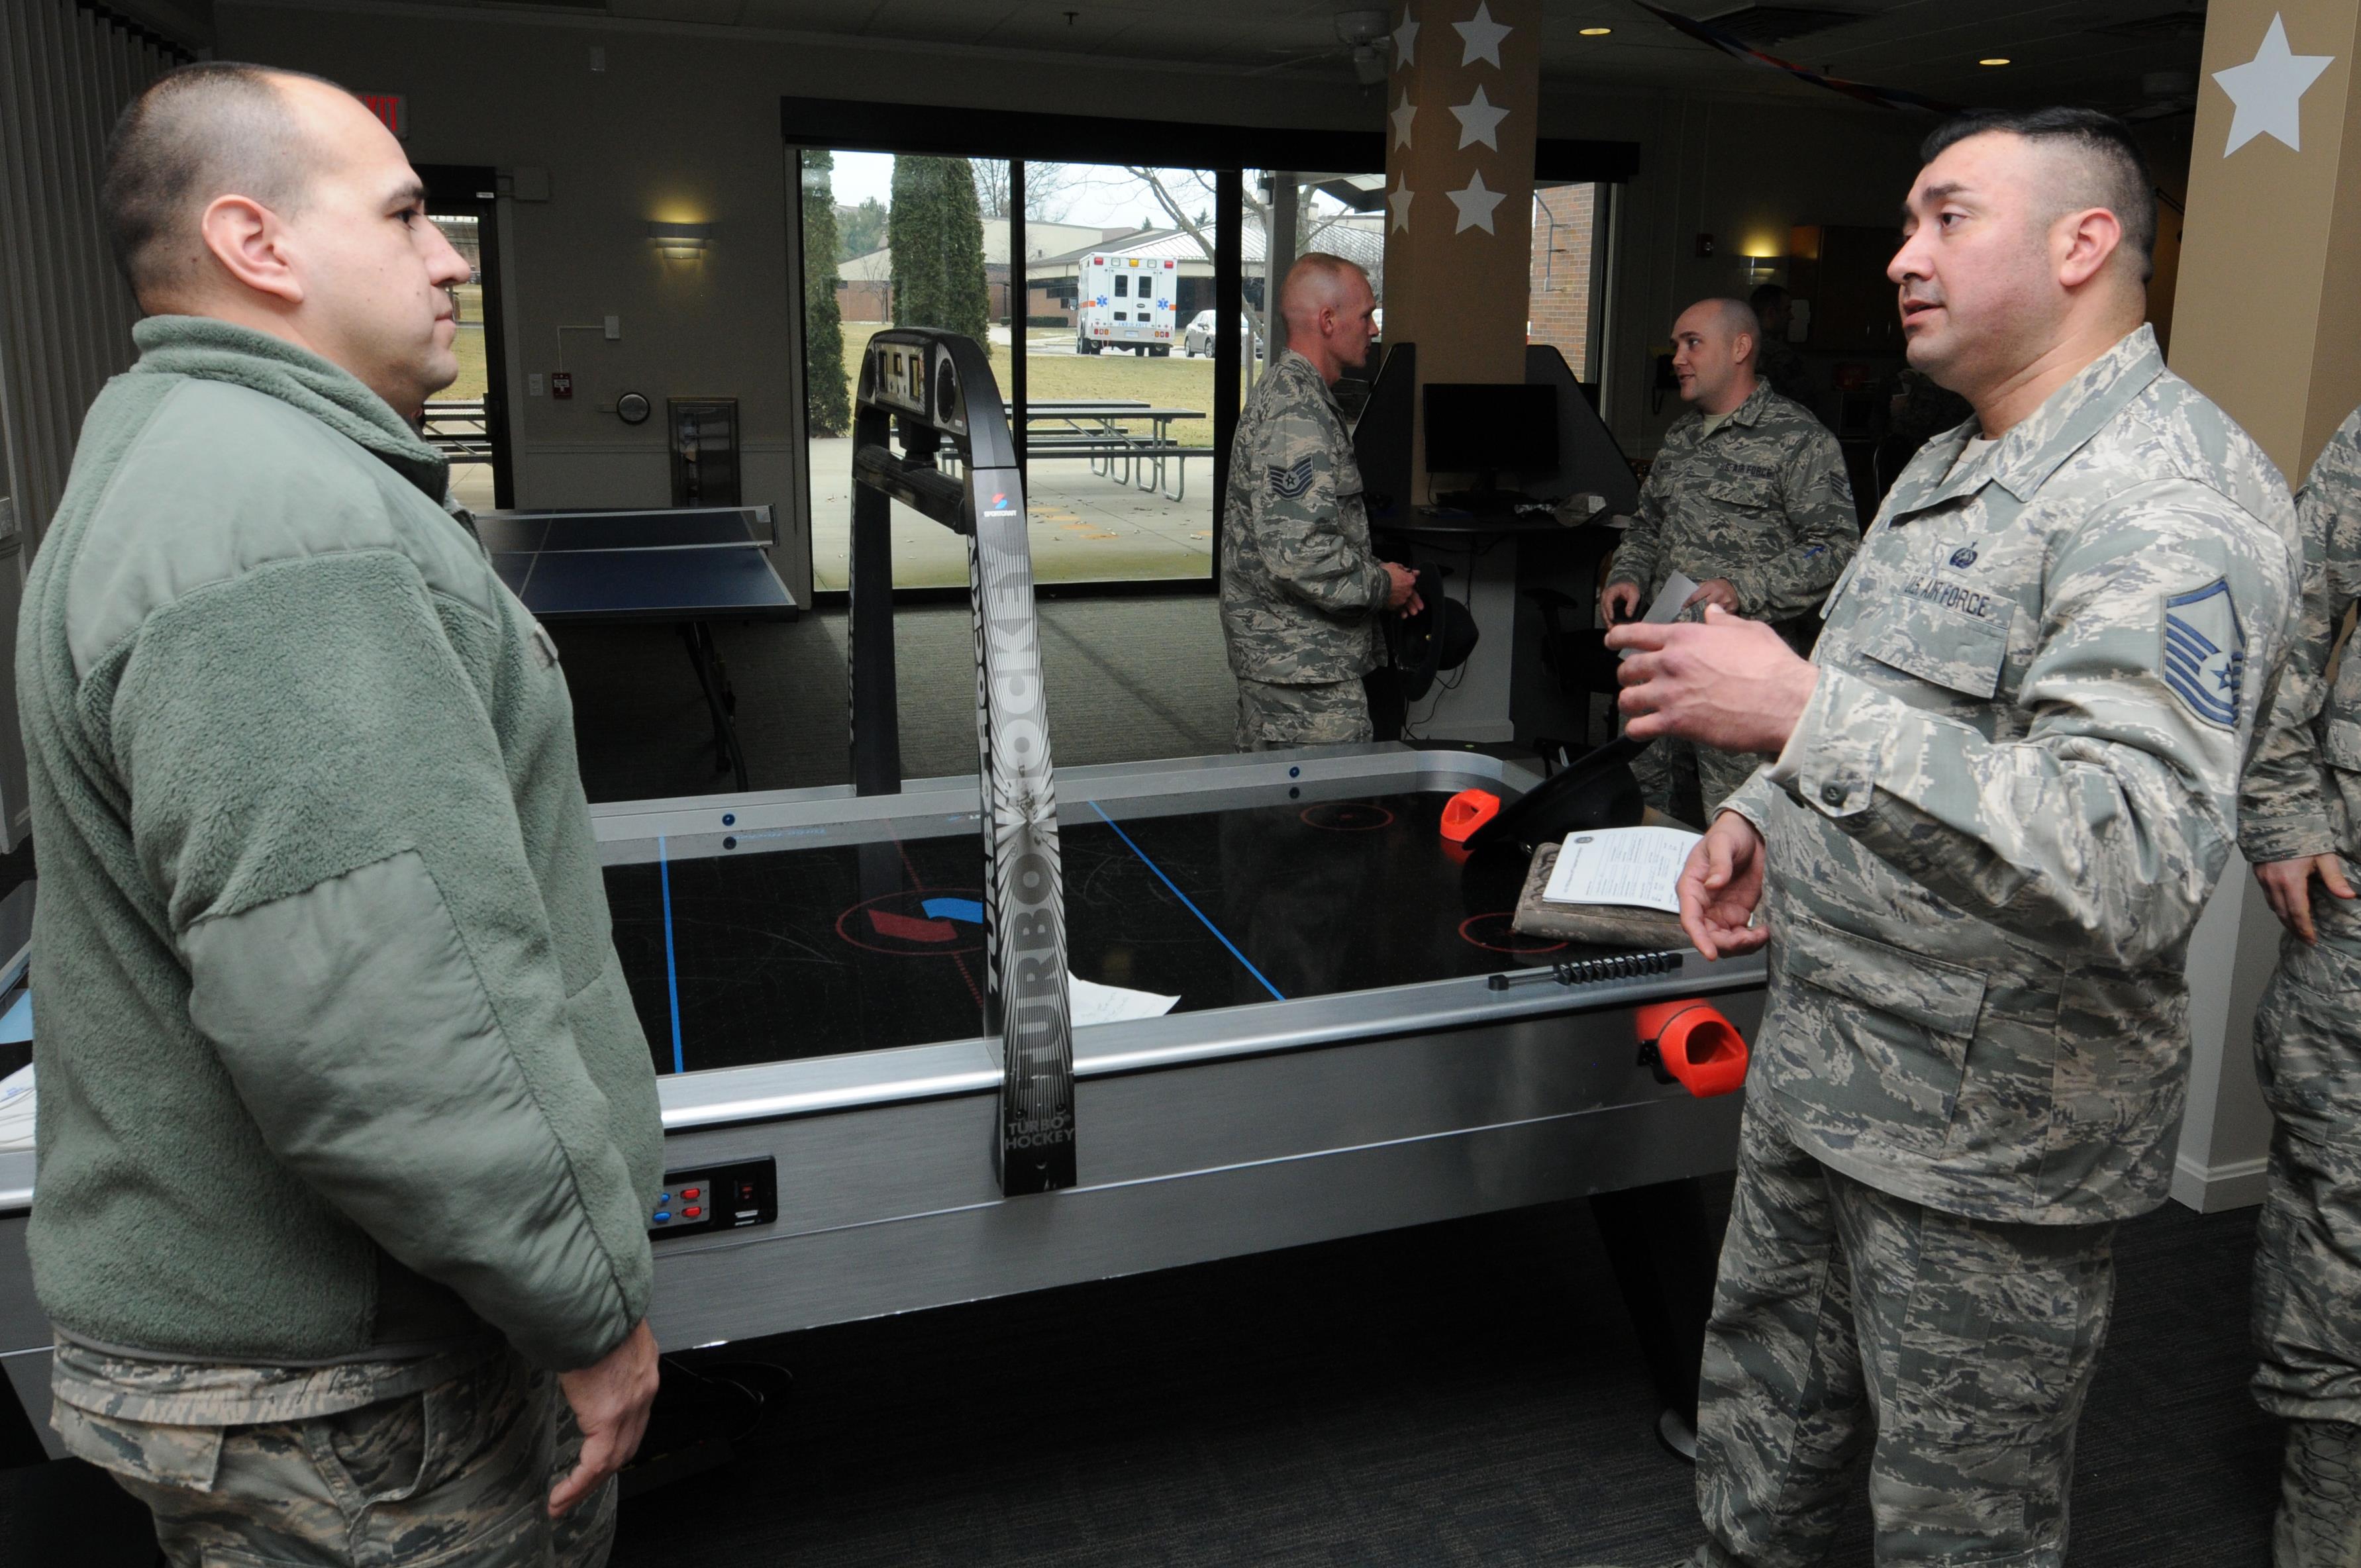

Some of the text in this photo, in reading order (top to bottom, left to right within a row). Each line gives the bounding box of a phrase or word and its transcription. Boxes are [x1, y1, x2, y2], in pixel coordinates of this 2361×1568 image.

[356, 95, 400, 131] XIT
[1732, 464, 1746, 473] AIR
[1746, 465, 1772, 477] FORCE
[1921, 578, 1943, 601] AIR
[1939, 584, 1989, 617] FORCE
[968, 534, 998, 994] TURBO HOCKEY
[1009, 854, 1061, 1090] TURBO
[1005, 1128, 1075, 1150] HOCKEY
